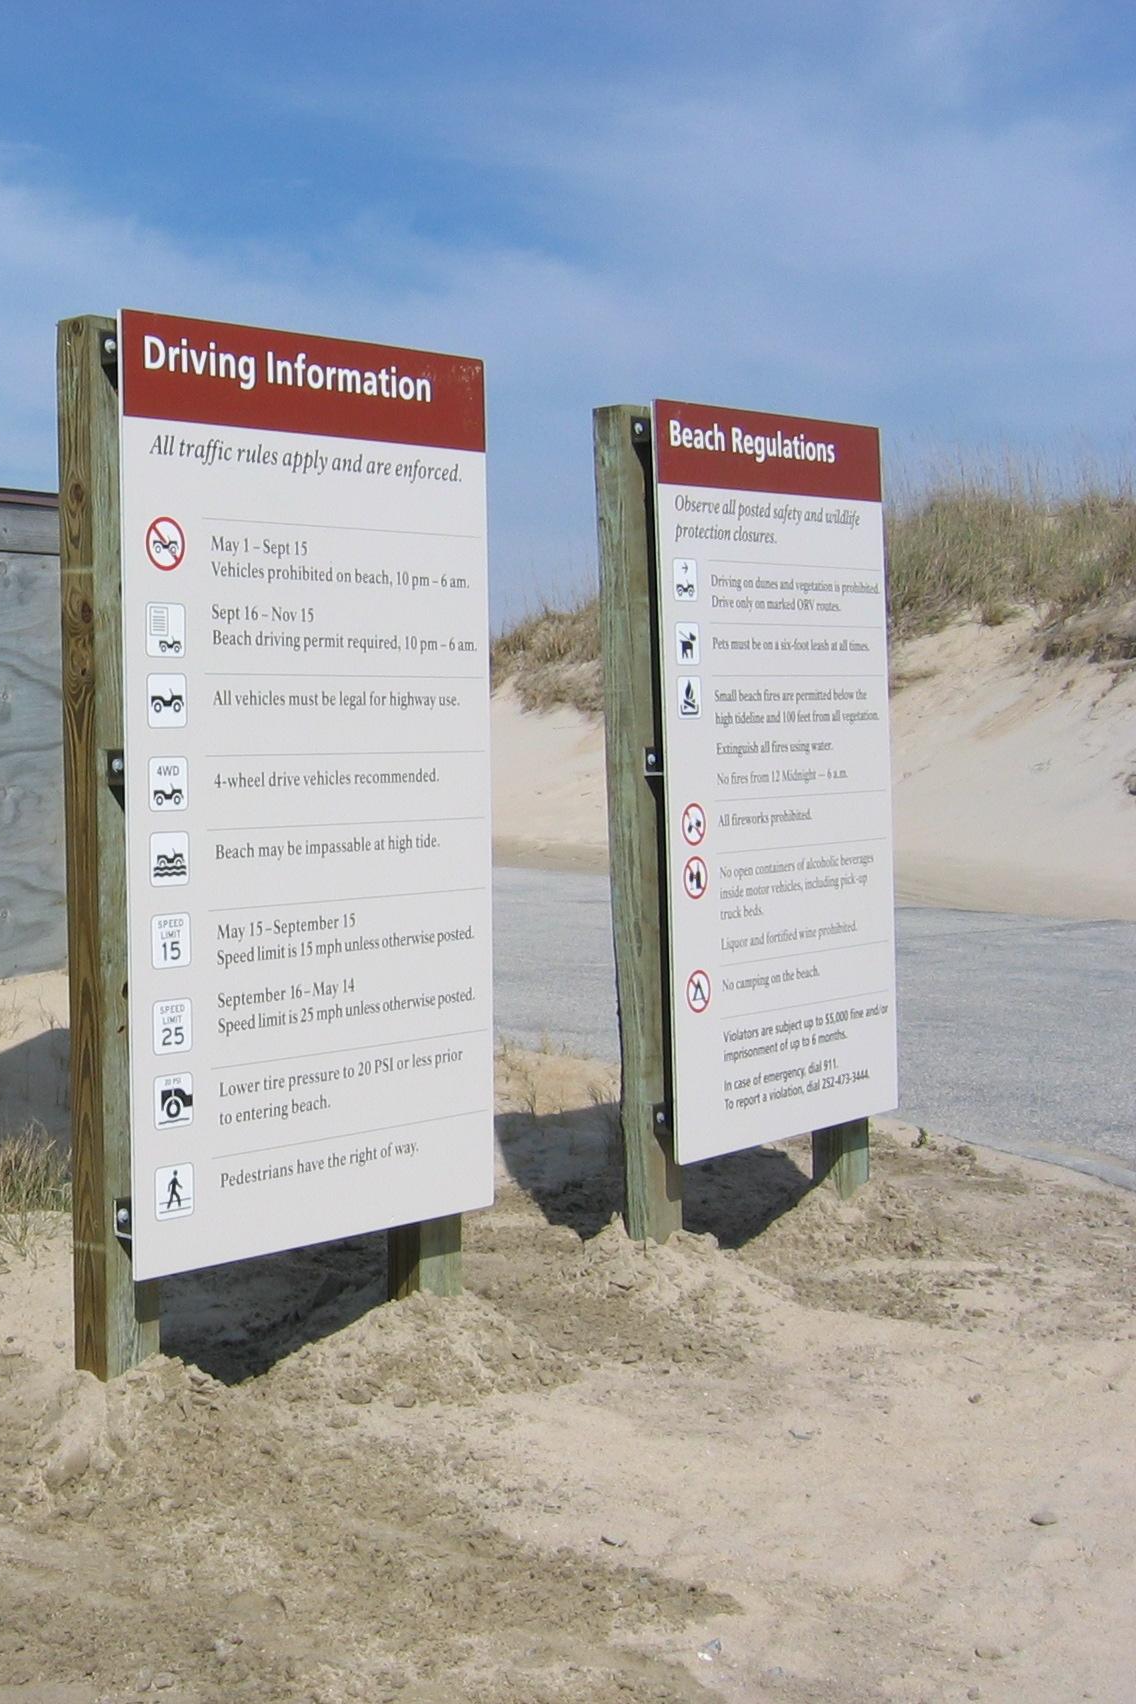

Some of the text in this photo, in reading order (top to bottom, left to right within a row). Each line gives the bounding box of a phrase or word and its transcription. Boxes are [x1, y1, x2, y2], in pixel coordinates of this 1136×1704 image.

[144, 336, 431, 402] Driving Information
[669, 420, 835, 463] Beach Regulations
[150, 435, 462, 483] All traffic rules apply and are enforced.
[675, 495, 860, 530] Observe all posted safety and wildlife
[675, 524, 731, 542] protection
[212, 536, 308, 559] May 1 Sept 15
[212, 561, 470, 590] Vehicles prohibited on beach, 10 pm 6 am.
[212, 604, 314, 624] Sept 16 Nov 15
[213, 630, 477, 654] Beach driving permit required, 10 pm 6 am.
[713, 637, 729, 649] Pets
[731, 640, 750, 650] must
[752, 638, 761, 650] be
[763, 642, 773, 650] on
[775, 642, 779, 650] a
[781, 638, 809, 650] six-foot
[811, 640, 829, 650] leash
[831, 642, 837, 651] at
[839, 640, 847, 651] all
[214, 690, 460, 710] All vehicles must be legal for highway use.
[157, 766, 179, 776] 4WD
[215, 768, 439, 788] 4-wheel drive vehicles recommended.
[718, 814, 729, 826] All
[731, 812, 769, 826] fireworks
[215, 834, 440, 860] Beach may be impassable at high tide.
[158, 919, 183, 928] SPEED
[161, 930, 180, 939] LIMIT
[217, 924, 244, 942] May
[343, 913, 356, 928] 15
[162, 941, 181, 962] 15
[217, 925, 474, 969] Speed limit is 15 mph unless otherwise posted.
[722, 979, 734, 991] No
[736, 974, 769, 990] camping
[771, 975, 781, 983] on
[783, 970, 794, 982] the
[218, 987, 286, 1011] September
[343, 978, 355, 993] 14
[160, 1004, 185, 1014] SPEED
[163, 1015, 182, 1025] LIMIT
[218, 987, 475, 1037] Speed limit is 25 mph unless otherwise posted.
[162, 1026, 184, 1047] 25
[219, 1049, 463, 1097] Lower tire pressure to 20 PSI or less prior
[724, 1080, 731, 1091] In
[734, 1078, 750, 1089] case
[753, 1072, 762, 1085] of
[808, 1061, 822, 1074] dial
[219, 1094, 330, 1125] to entering beach.
[221, 1142, 419, 1188] Pedestrians have the right of way.
